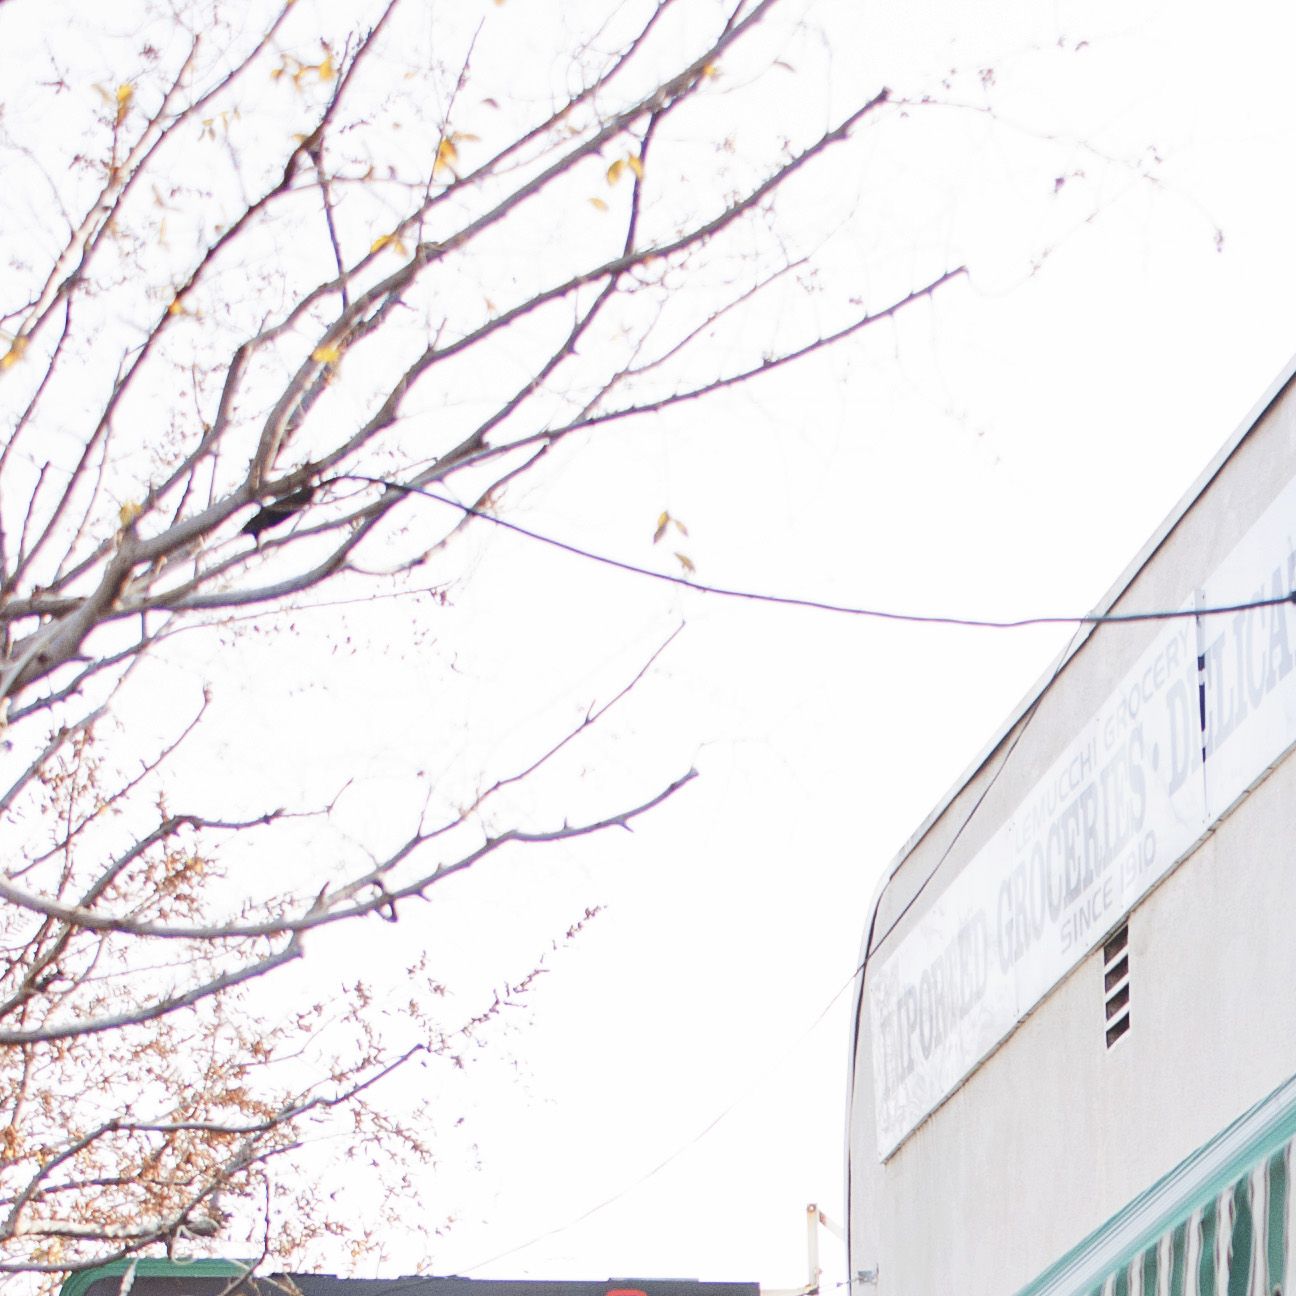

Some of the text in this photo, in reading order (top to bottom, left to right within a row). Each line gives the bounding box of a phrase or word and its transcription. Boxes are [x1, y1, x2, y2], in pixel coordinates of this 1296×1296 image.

[1104, 626, 1190, 752] GROCERY
[996, 719, 1147, 974] GROCERIES
[1060, 829, 1156, 954] SINCE 1910
